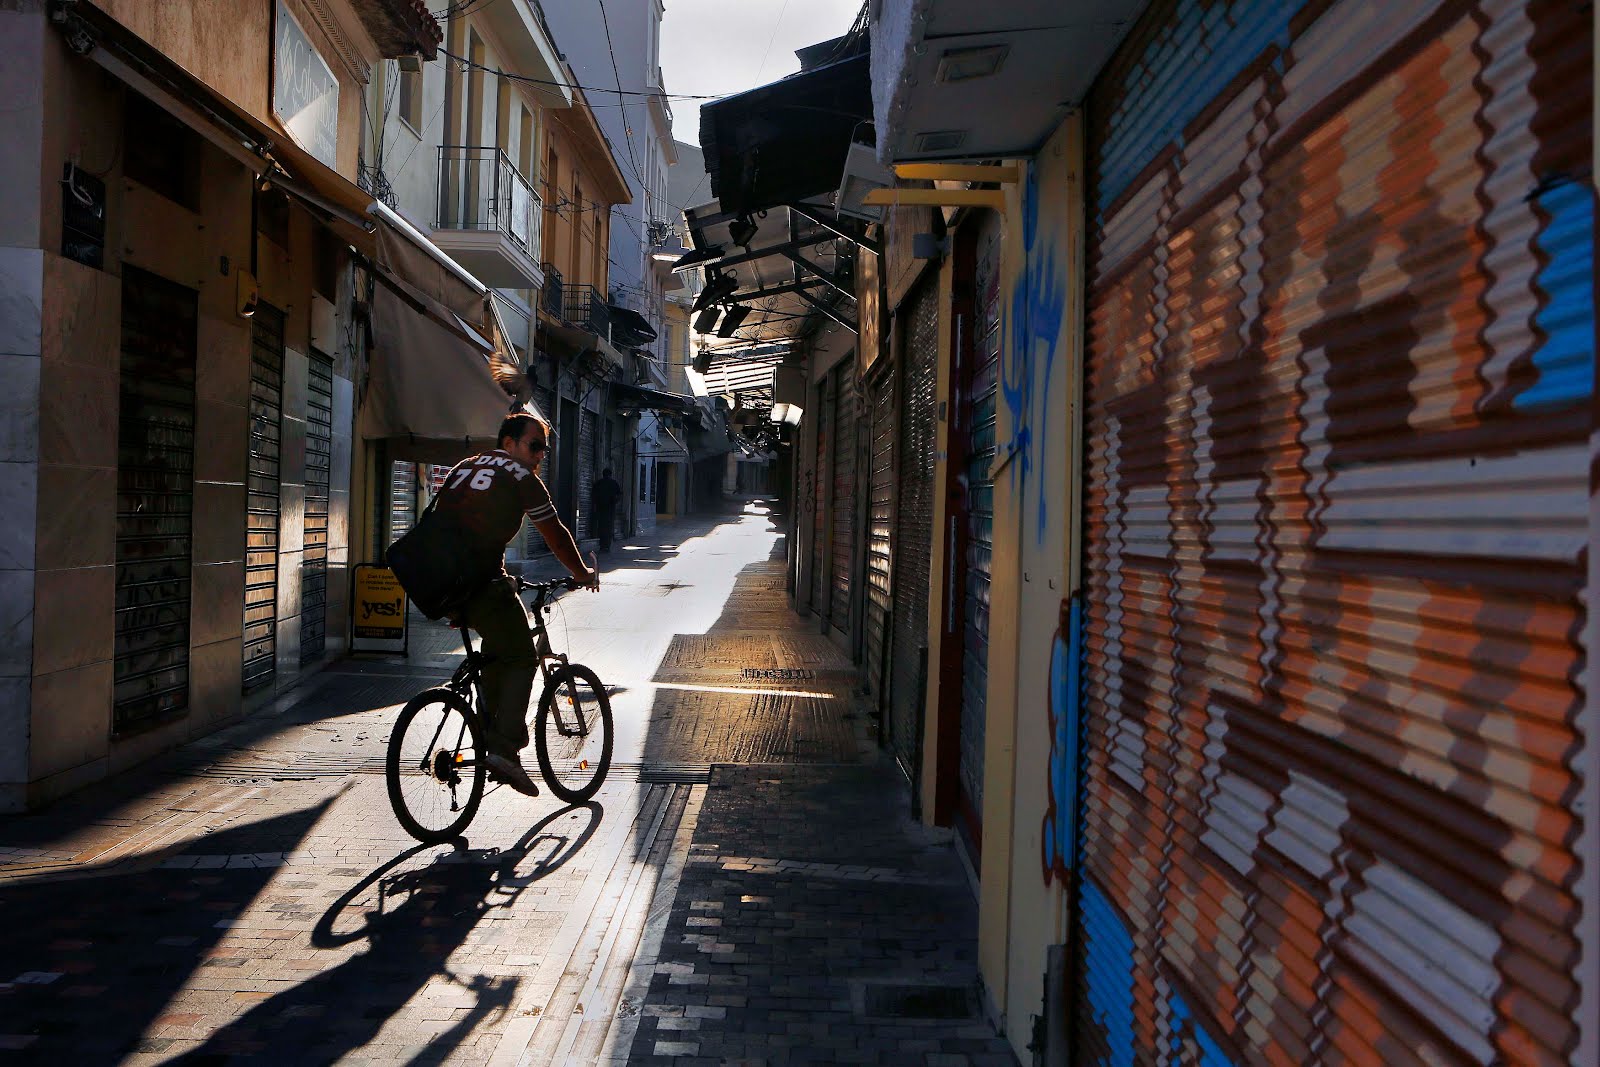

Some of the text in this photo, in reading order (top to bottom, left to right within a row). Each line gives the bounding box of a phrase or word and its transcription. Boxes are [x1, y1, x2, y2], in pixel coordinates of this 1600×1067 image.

[293, 39, 336, 136] Columbia
[450, 468, 496, 491] 76
[361, 598, 402, 620] yes!
